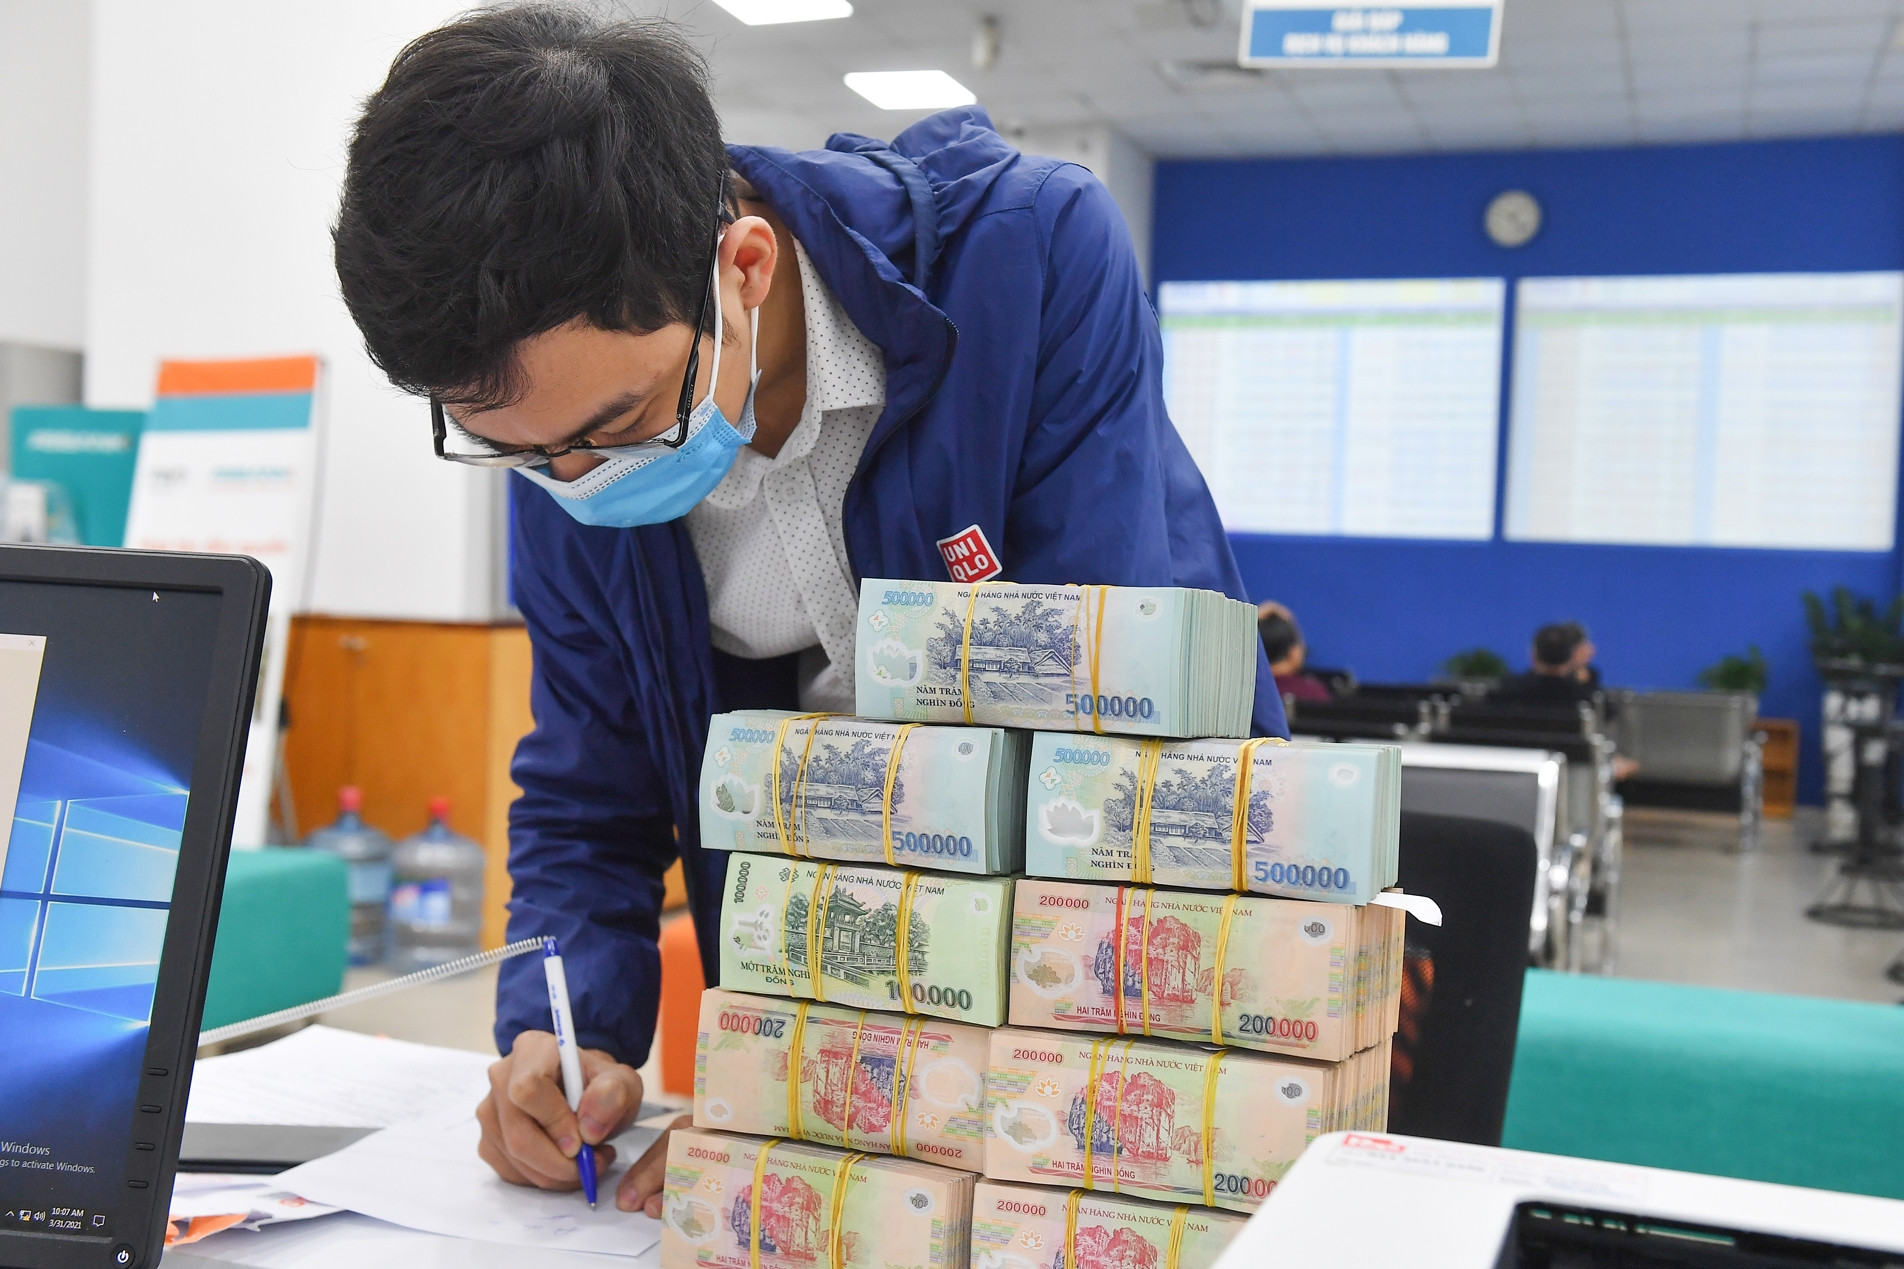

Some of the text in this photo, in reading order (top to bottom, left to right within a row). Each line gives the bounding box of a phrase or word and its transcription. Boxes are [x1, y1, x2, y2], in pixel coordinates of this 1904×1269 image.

[943, 537, 978, 562] UNI
[952, 554, 989, 582] QLO
[980, 590, 1002, 599] HÀNG
[1003, 590, 1019, 599] NHÀ
[1021, 591, 1044, 600] NƯỚC
[1045, 592, 1062, 601] VIỆT
[916, 685, 937, 695] NĂM
[916, 697, 947, 707] NGHÌN
[835, 729, 850, 737] NHÀ
[852, 730, 873, 739] NƯỚC
[875, 732, 891, 741] VIỆT
[1161, 751, 1185, 761] HÀNG
[1187, 752, 1204, 762] NHÀ
[1207, 754, 1231, 764] NƯỚC
[1253, 758, 1272, 766] NAM
[756, 819, 775, 828] NĂM
[1091, 847, 1113, 857] NĂM
[1090, 860, 1124, 870] NGHÌN
[856, 876, 874, 886] NHÀ
[876, 879, 902, 890] NƯỚC
[925, 886, 945, 896] NAM
[1161, 901, 1184, 911] NHÀ
[1184, 902, 1209, 913] NƯỚC
[741, 960, 760, 972] MỘT
[759, 963, 786, 976] TRĂM
[1076, 1006, 1089, 1015] HAI
[1091, 1006, 1112, 1017] TRĂM
[1107, 1053, 1133, 1064] HÀNG
[1134, 1056, 1155, 1066] NHÀ
[1156, 1058, 1182, 1069] NƯỚC
[1184, 1062, 1204, 1072] VIỆT
[1, 1141, 50, 1155] Windows
[11, 1159, 20, 1167] to
[22, 1160, 55, 1170] activate
[56, 1161, 95, 1173] Windows.
[767, 1156, 789, 1168] HÀNG
[789, 1160, 807, 1171] NHÀ
[808, 1164, 830, 1176] NƯỚC
[849, 1172, 867, 1183] NAM
[1052, 1160, 1064, 1169] HAI
[51, 1207, 84, 1217] 10:07 AM
[48, 1219, 82, 1229] 3/31/2021
[1089, 1207, 1115, 1219] HÀNG
[1117, 1211, 1137, 1222] NHÀ
[1138, 1213, 1165, 1226] NƯỚC
[1187, 1222, 1209, 1232] NAM
